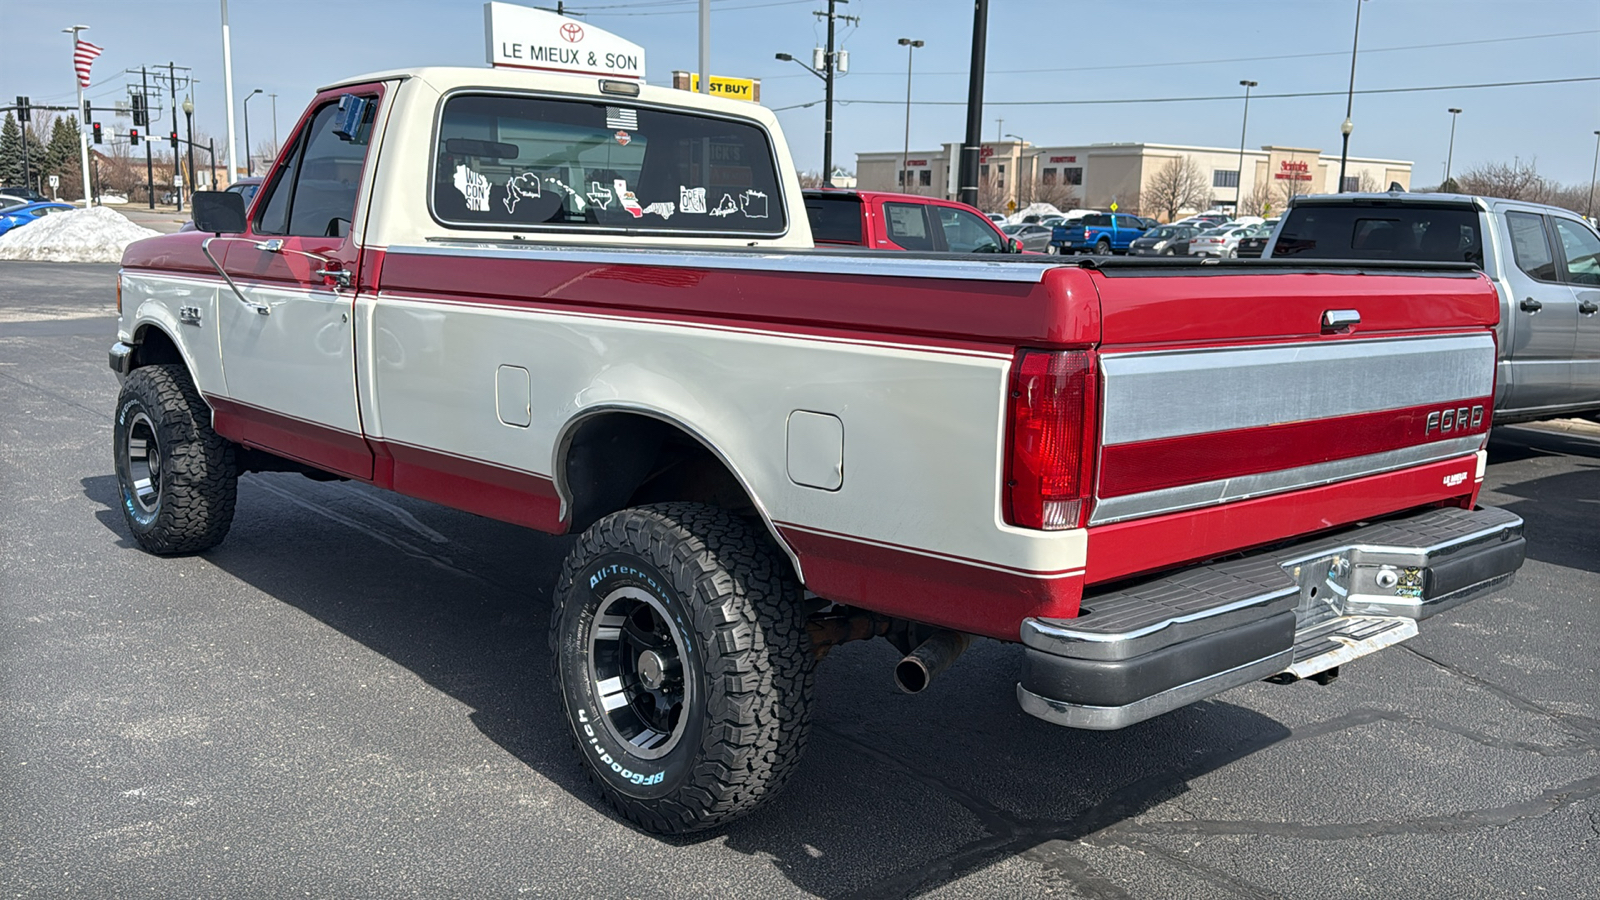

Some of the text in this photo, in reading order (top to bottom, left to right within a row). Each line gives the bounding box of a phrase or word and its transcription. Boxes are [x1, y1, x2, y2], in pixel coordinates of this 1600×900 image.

[503, 42, 638, 71] LE MIEUX & SON
[696, 81, 749, 95] ST BUY
[466, 184, 485, 200] CON
[1425, 405, 1483, 436] FORD
[589, 564, 670, 604] All-Terrain
[578, 708, 666, 786] BFGoodrich
